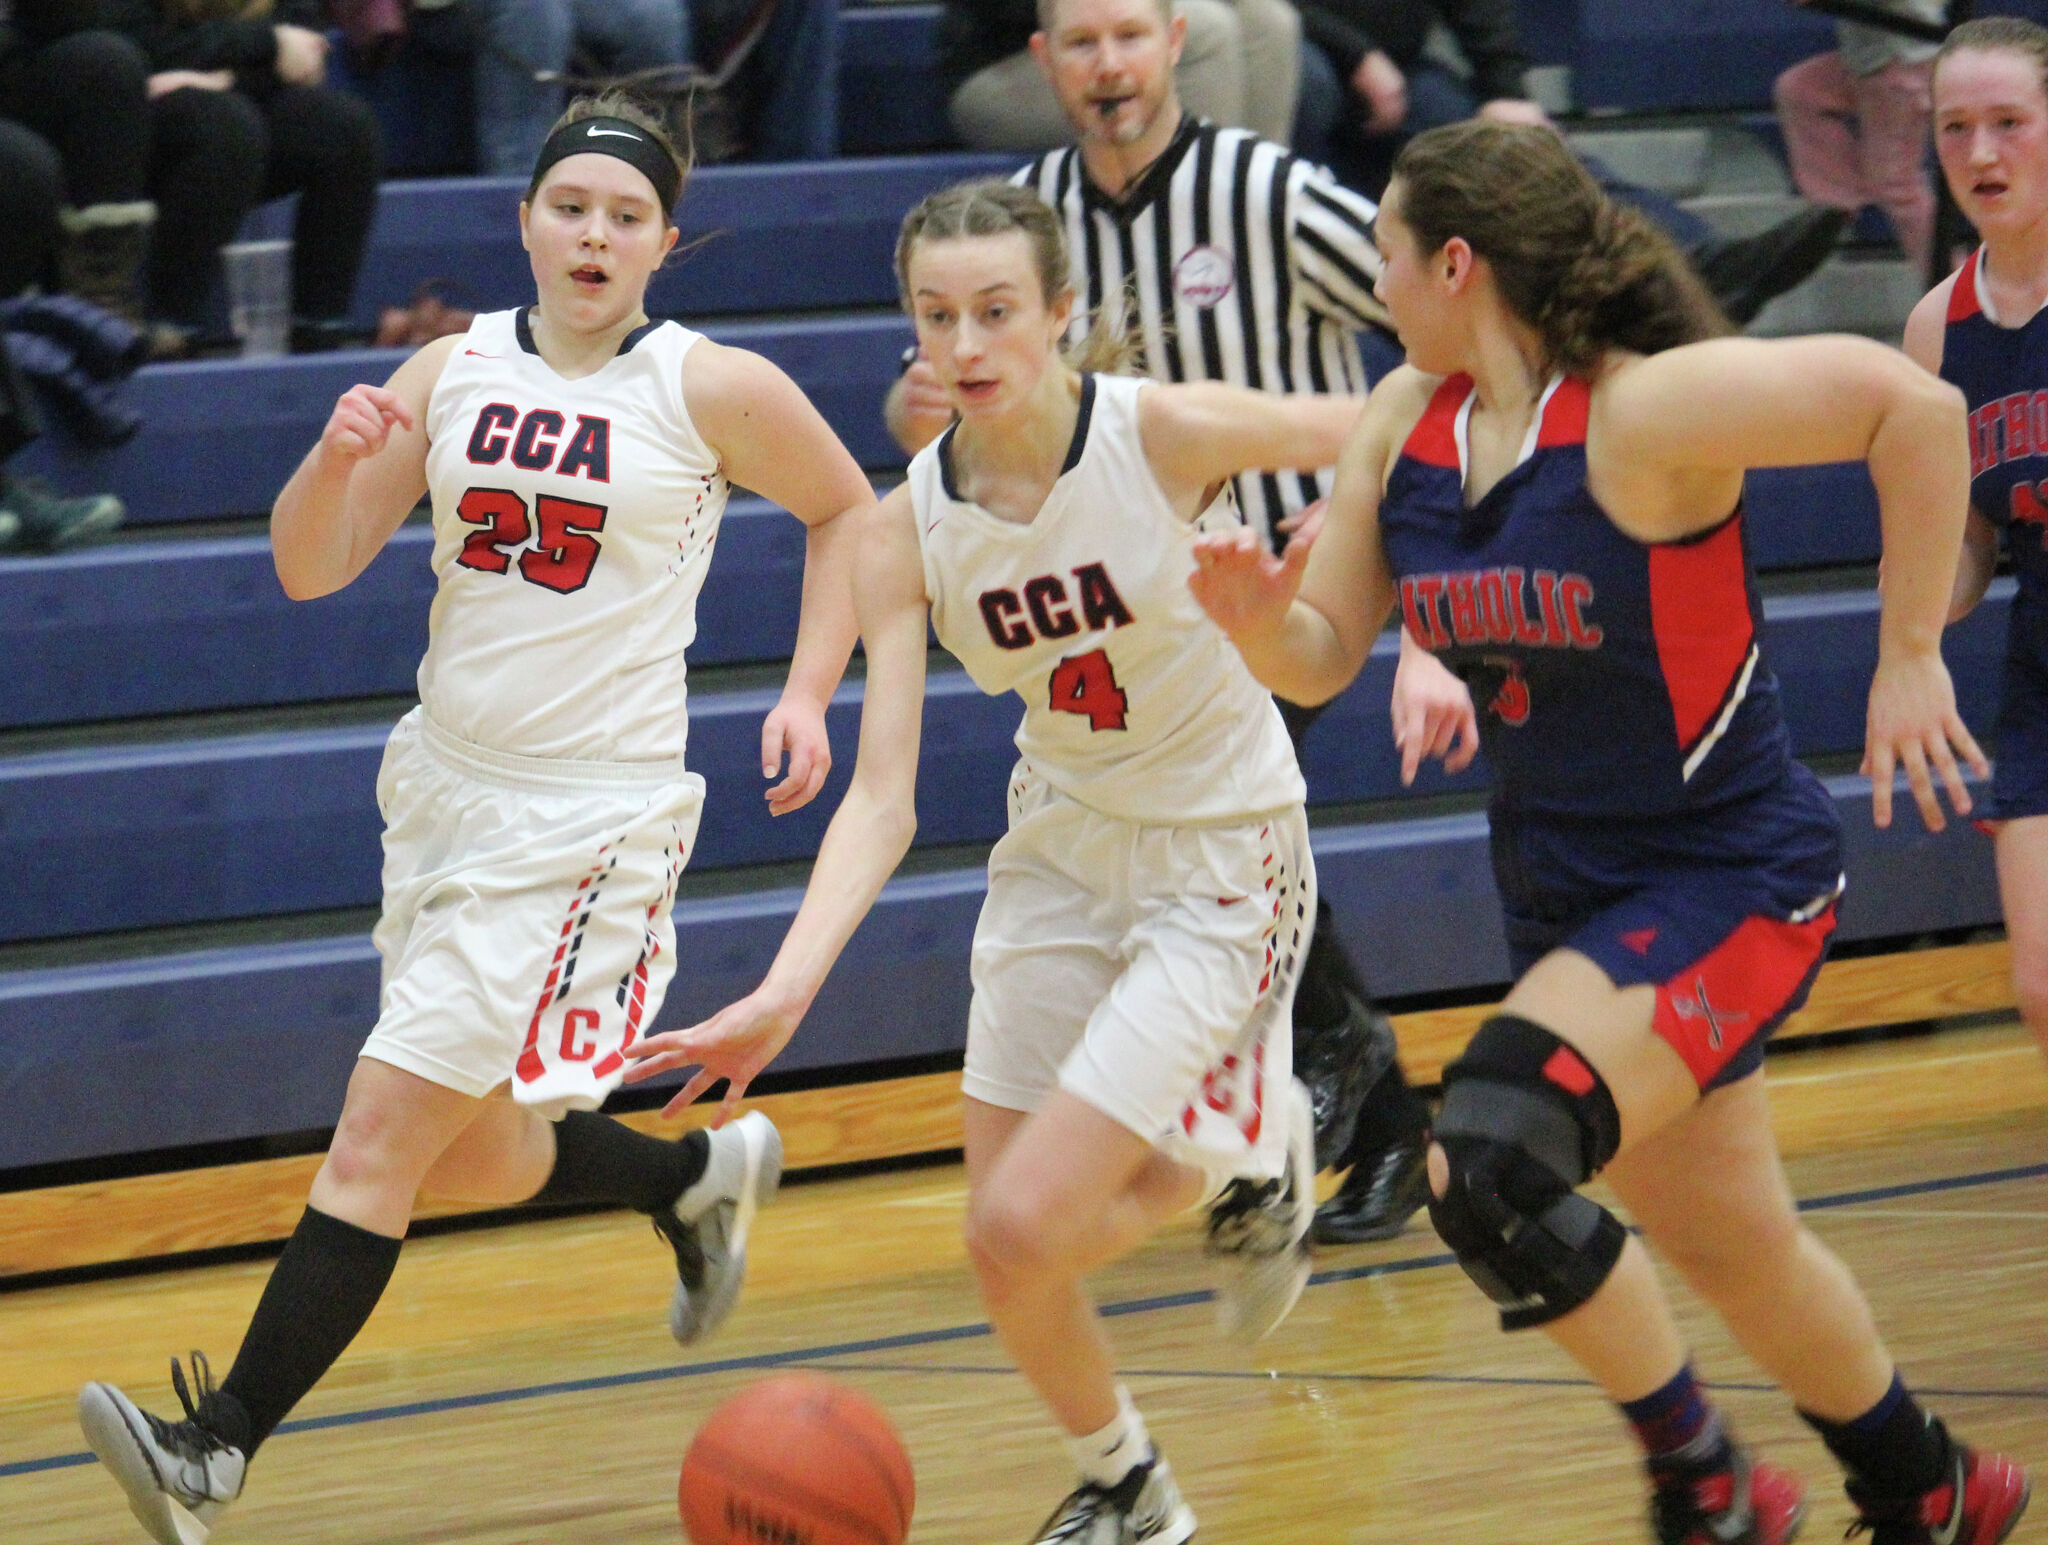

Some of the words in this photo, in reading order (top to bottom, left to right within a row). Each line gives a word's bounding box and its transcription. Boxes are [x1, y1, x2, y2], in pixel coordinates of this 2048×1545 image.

[466, 402, 610, 483] CCA
[455, 486, 609, 595] 25
[978, 560, 1137, 652] CCA
[1049, 648, 1129, 732] 4
[559, 1007, 601, 1063] C
